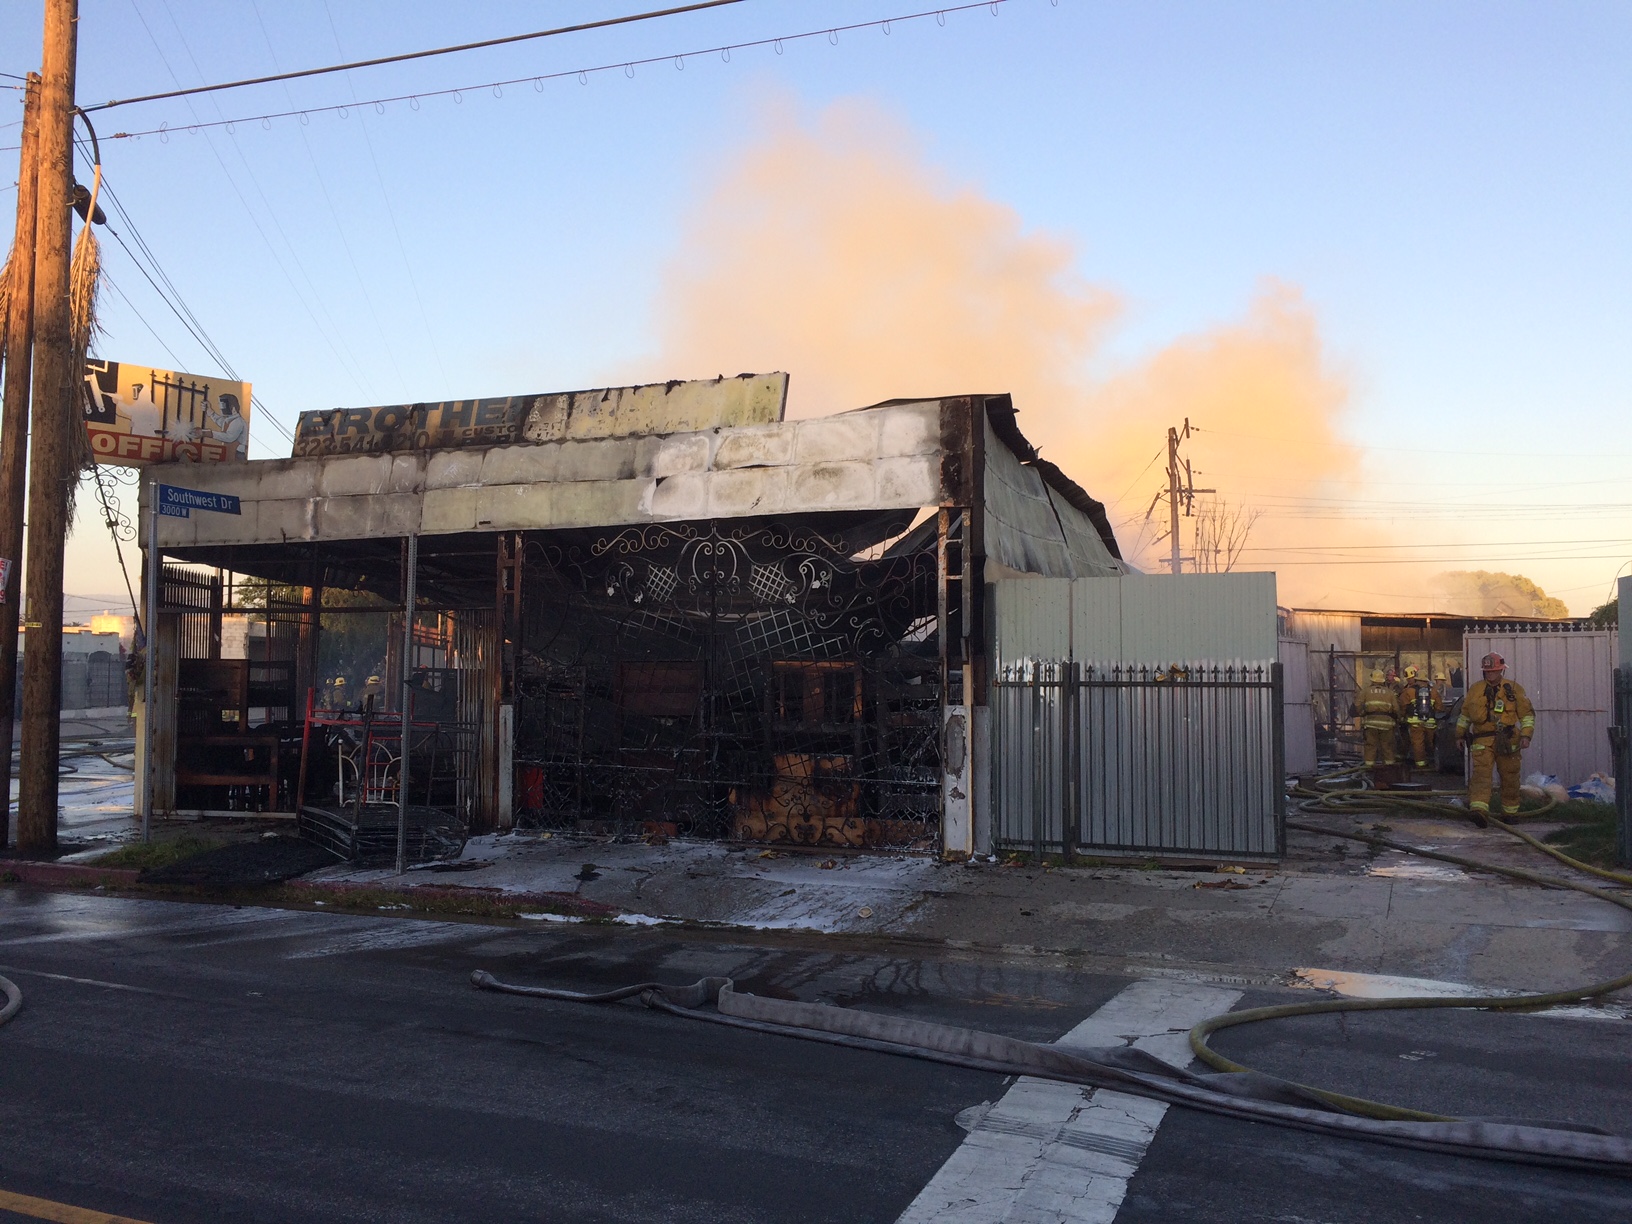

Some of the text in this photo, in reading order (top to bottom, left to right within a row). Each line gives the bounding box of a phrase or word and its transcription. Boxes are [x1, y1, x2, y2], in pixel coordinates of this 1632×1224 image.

[91, 434, 224, 463] OFFICE
[161, 504, 188, 517] 3000 W
[167, 488, 233, 511] Southwest Dr
